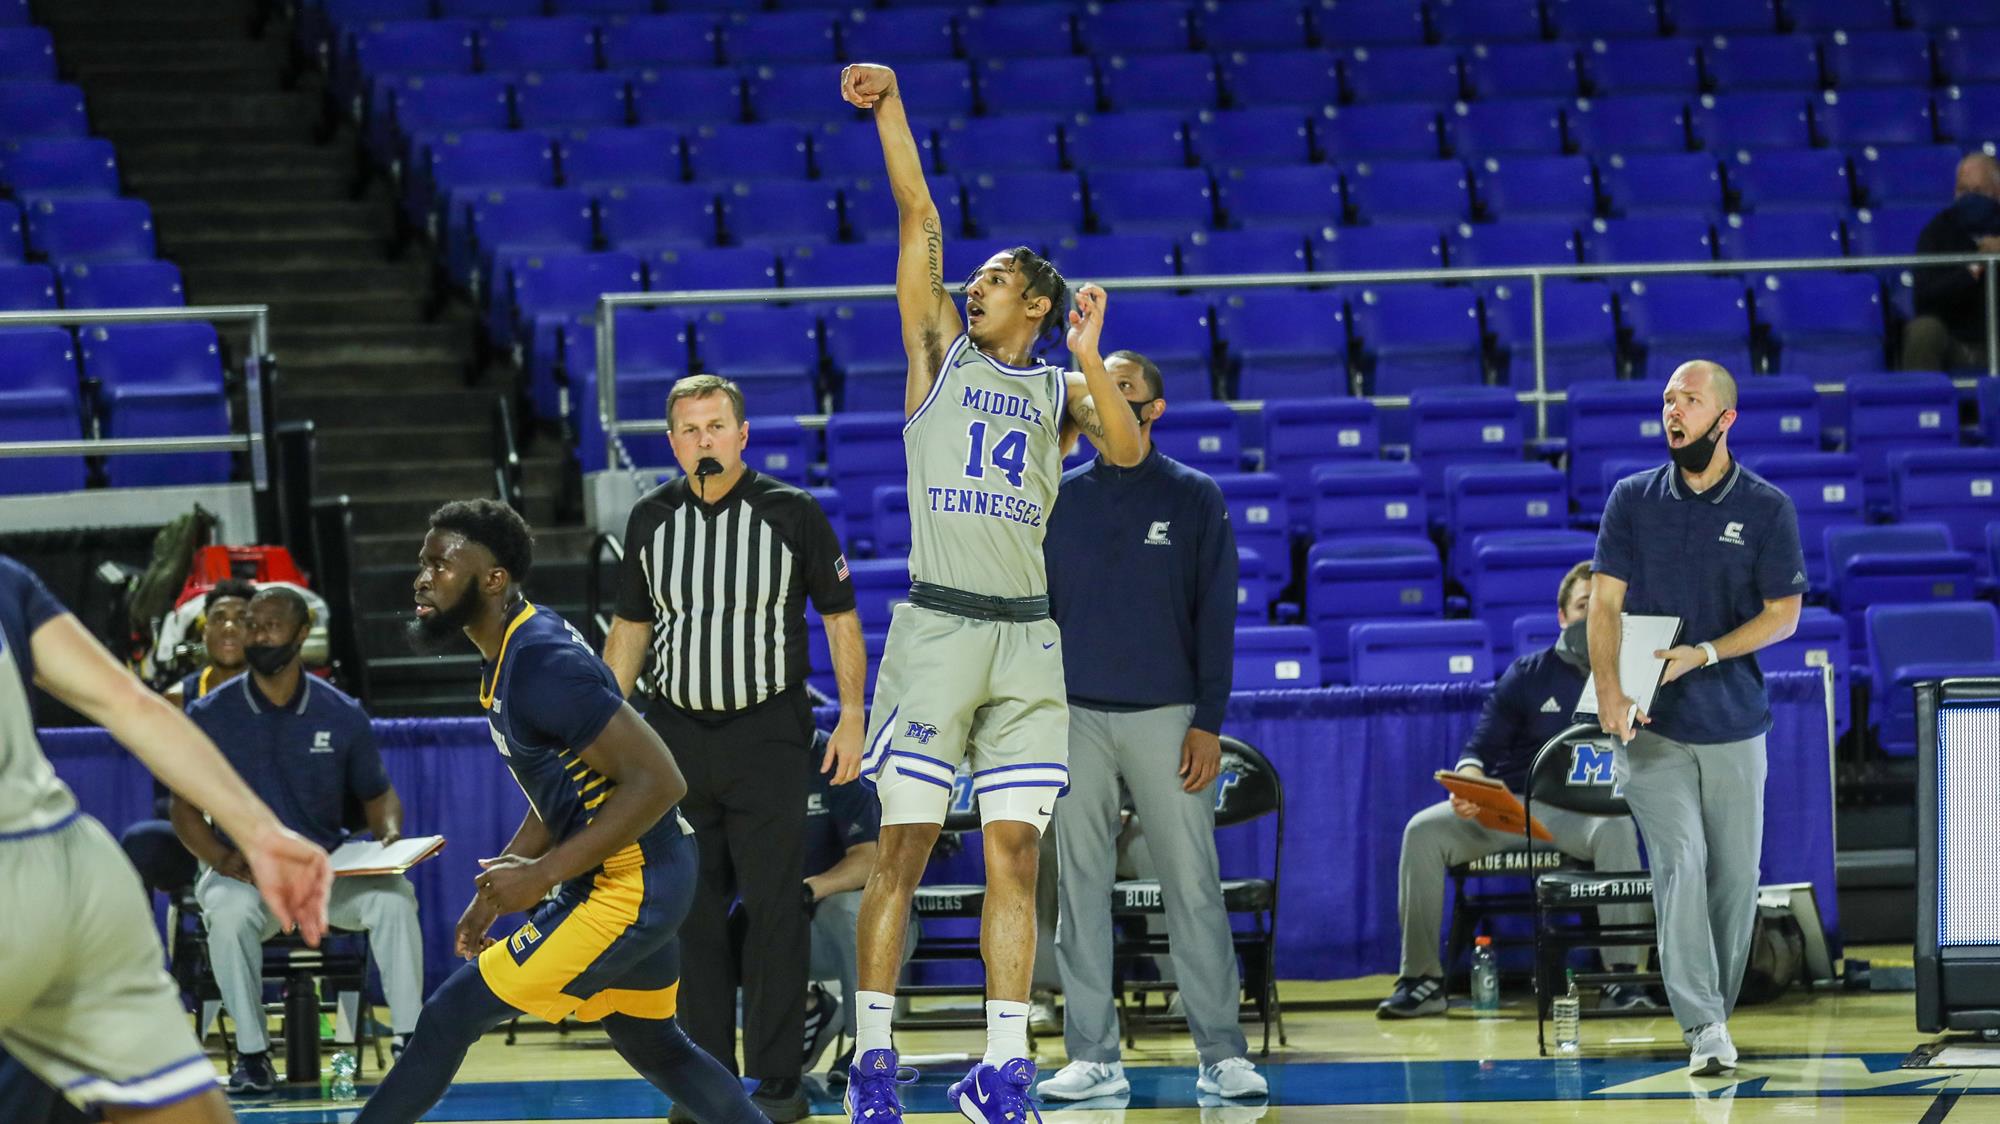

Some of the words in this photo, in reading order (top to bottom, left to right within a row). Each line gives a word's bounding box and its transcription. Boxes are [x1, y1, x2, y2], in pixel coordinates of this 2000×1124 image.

[923, 217, 942, 298] Humble
[963, 419, 1029, 490] 14
[1126, 889, 1161, 907] BLUE
[1570, 883, 1607, 898] BLUE
[1483, 975, 1495, 990] G
